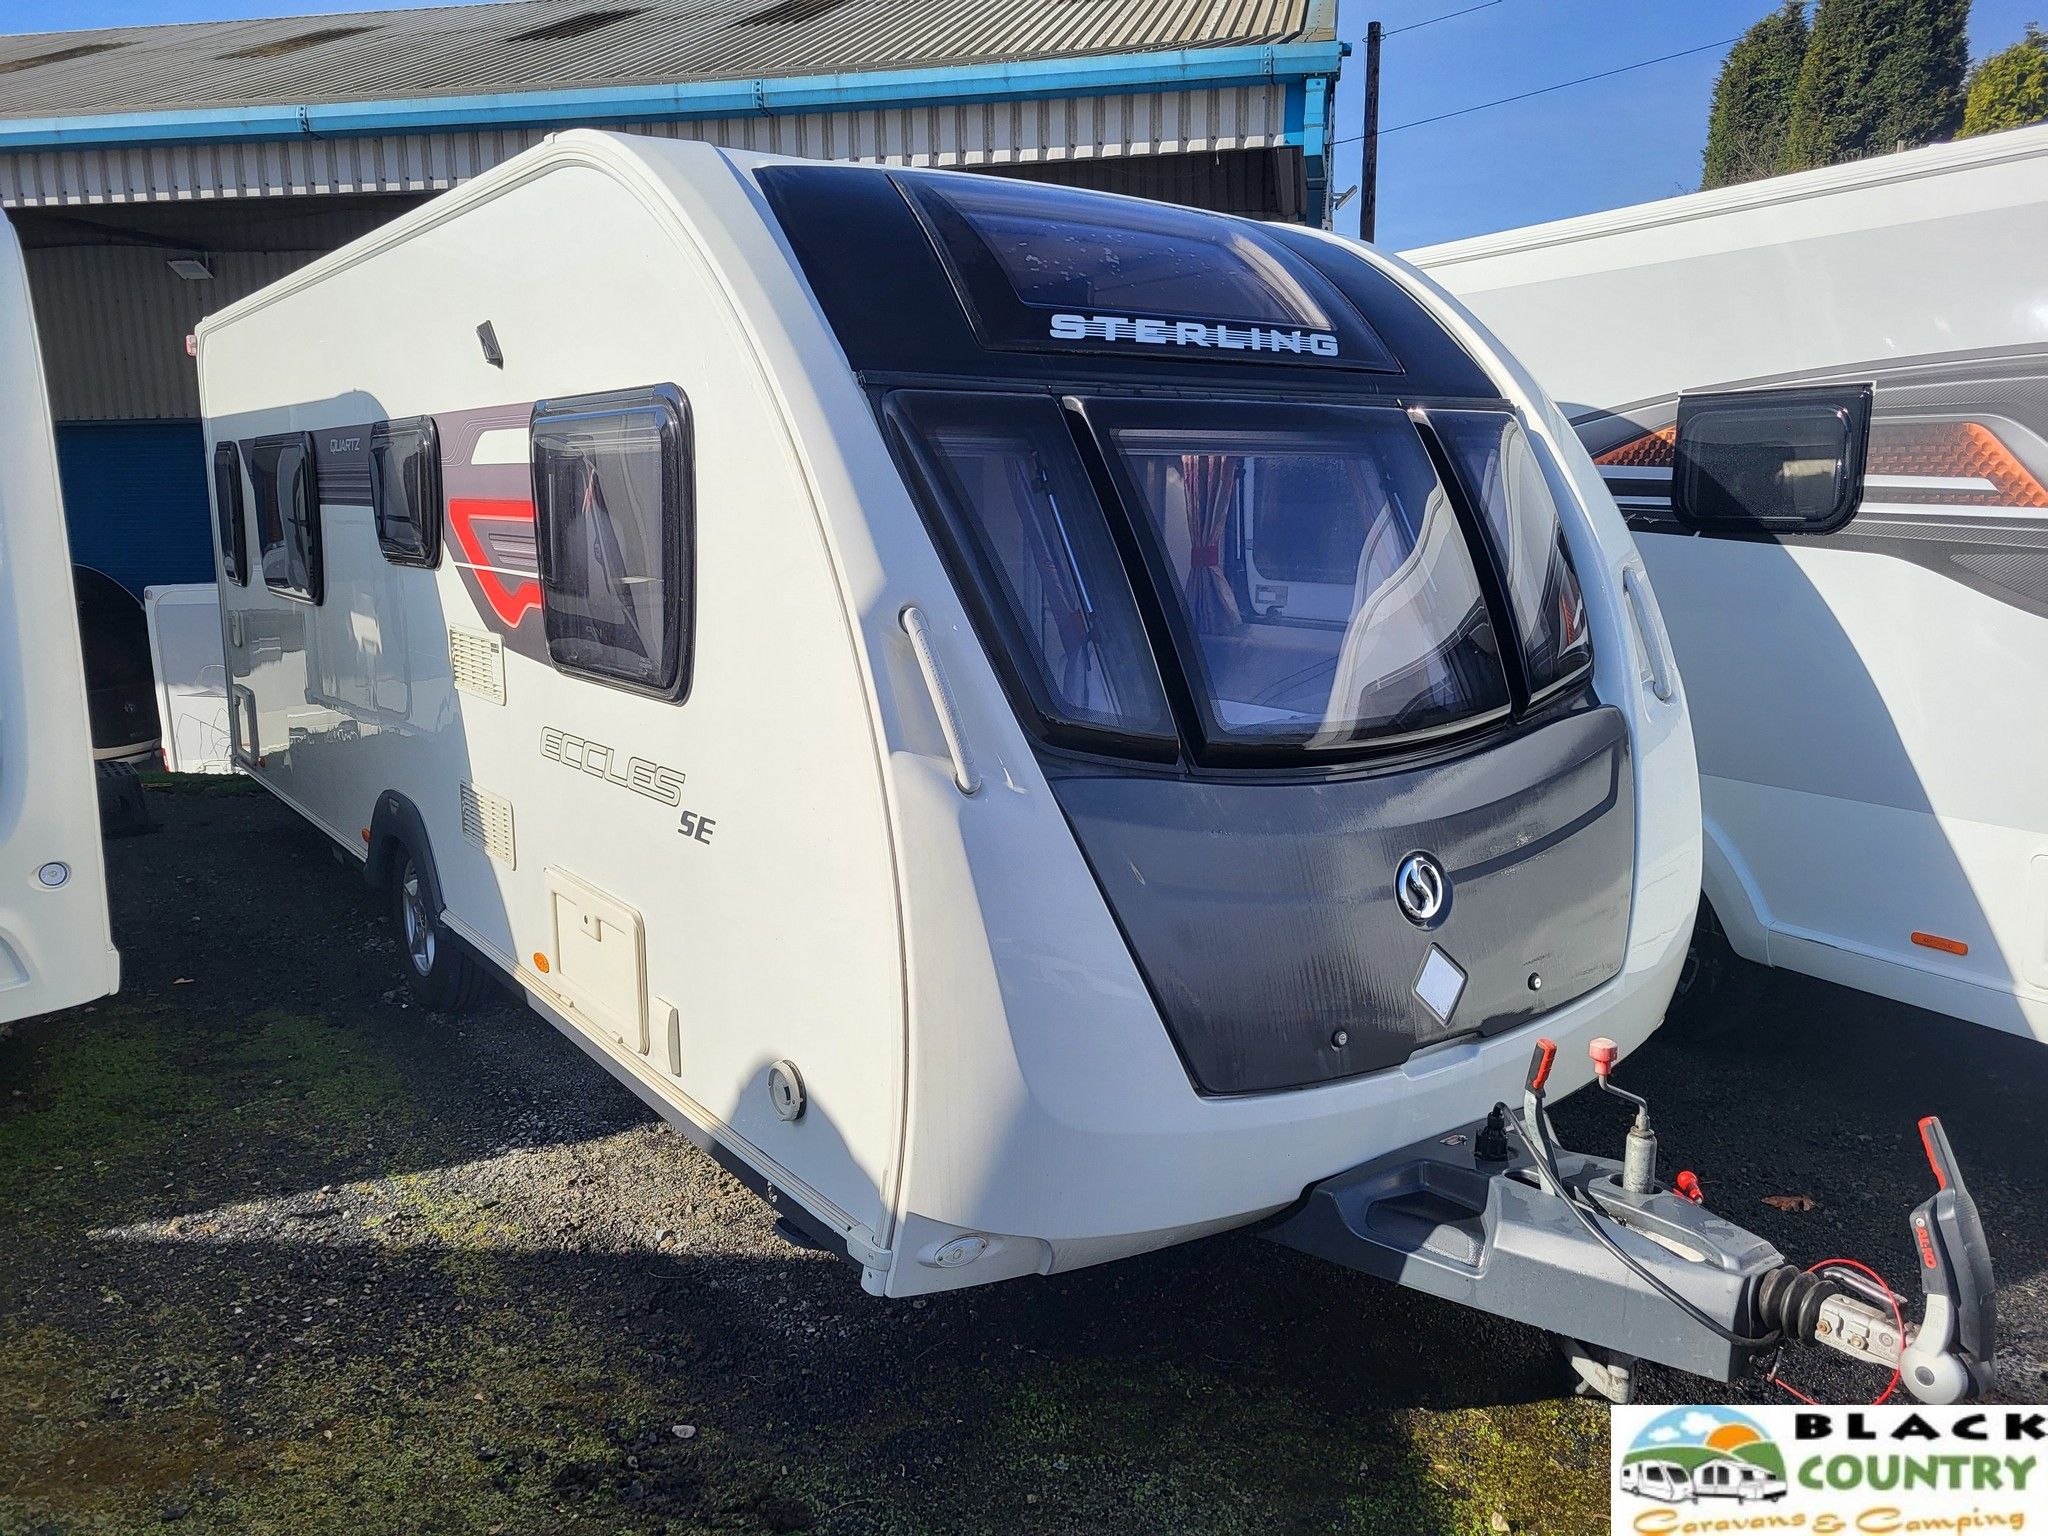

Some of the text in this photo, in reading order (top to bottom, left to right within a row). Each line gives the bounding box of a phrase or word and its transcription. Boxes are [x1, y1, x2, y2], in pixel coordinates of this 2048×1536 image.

[1050, 314, 1338, 356] STERLING
[330, 437, 360, 455] QUARTZ
[540, 726, 686, 807] ECCLES
[677, 810, 716, 845] SE
